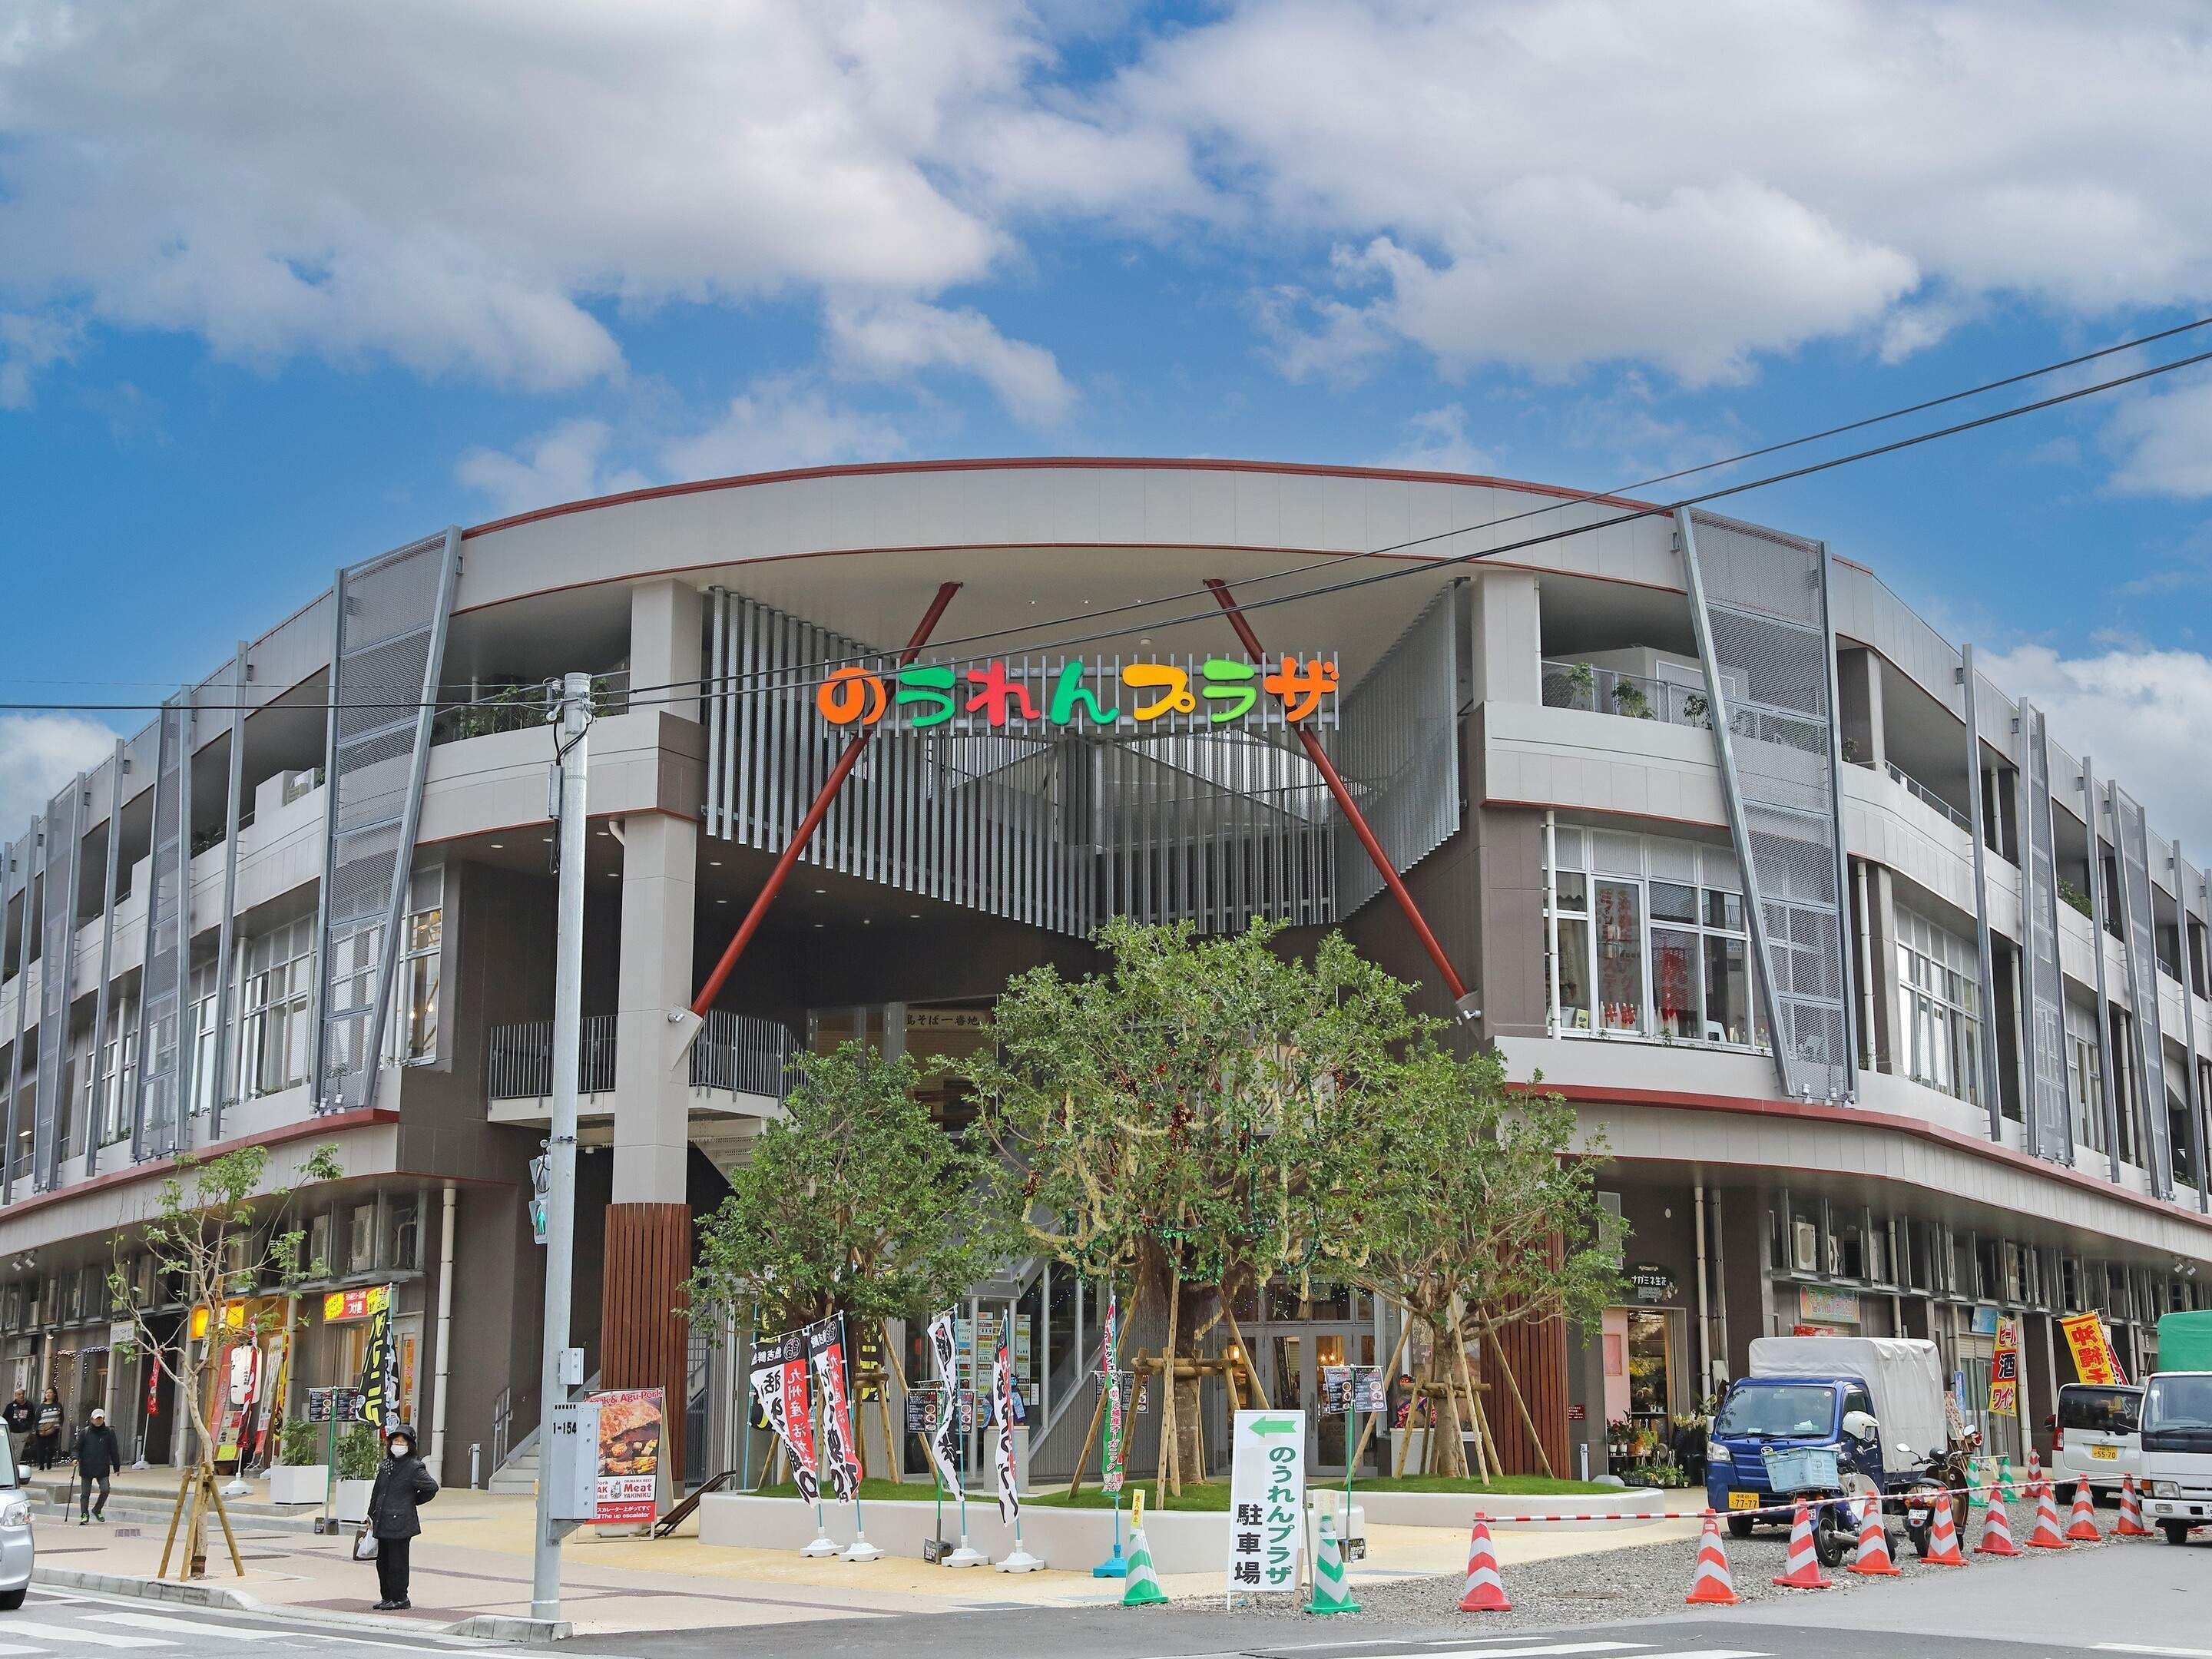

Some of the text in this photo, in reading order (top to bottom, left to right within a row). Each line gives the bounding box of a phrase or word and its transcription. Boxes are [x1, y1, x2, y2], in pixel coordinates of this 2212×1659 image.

[817, 661, 1339, 727] のうれんプラザ
[1998, 1352, 2016, 1379] 酒
[621, 1389, 662, 1402] Agu-Pork
[553, 1422, 577, 1435] 1-154
[624, 1483, 652, 1492] Meat
[1736, 1500, 1757, 1508] 77-77
[1266, 1446, 1296, 1584] のうれんプラザ
[1234, 1504, 1263, 1584] 駐車場
